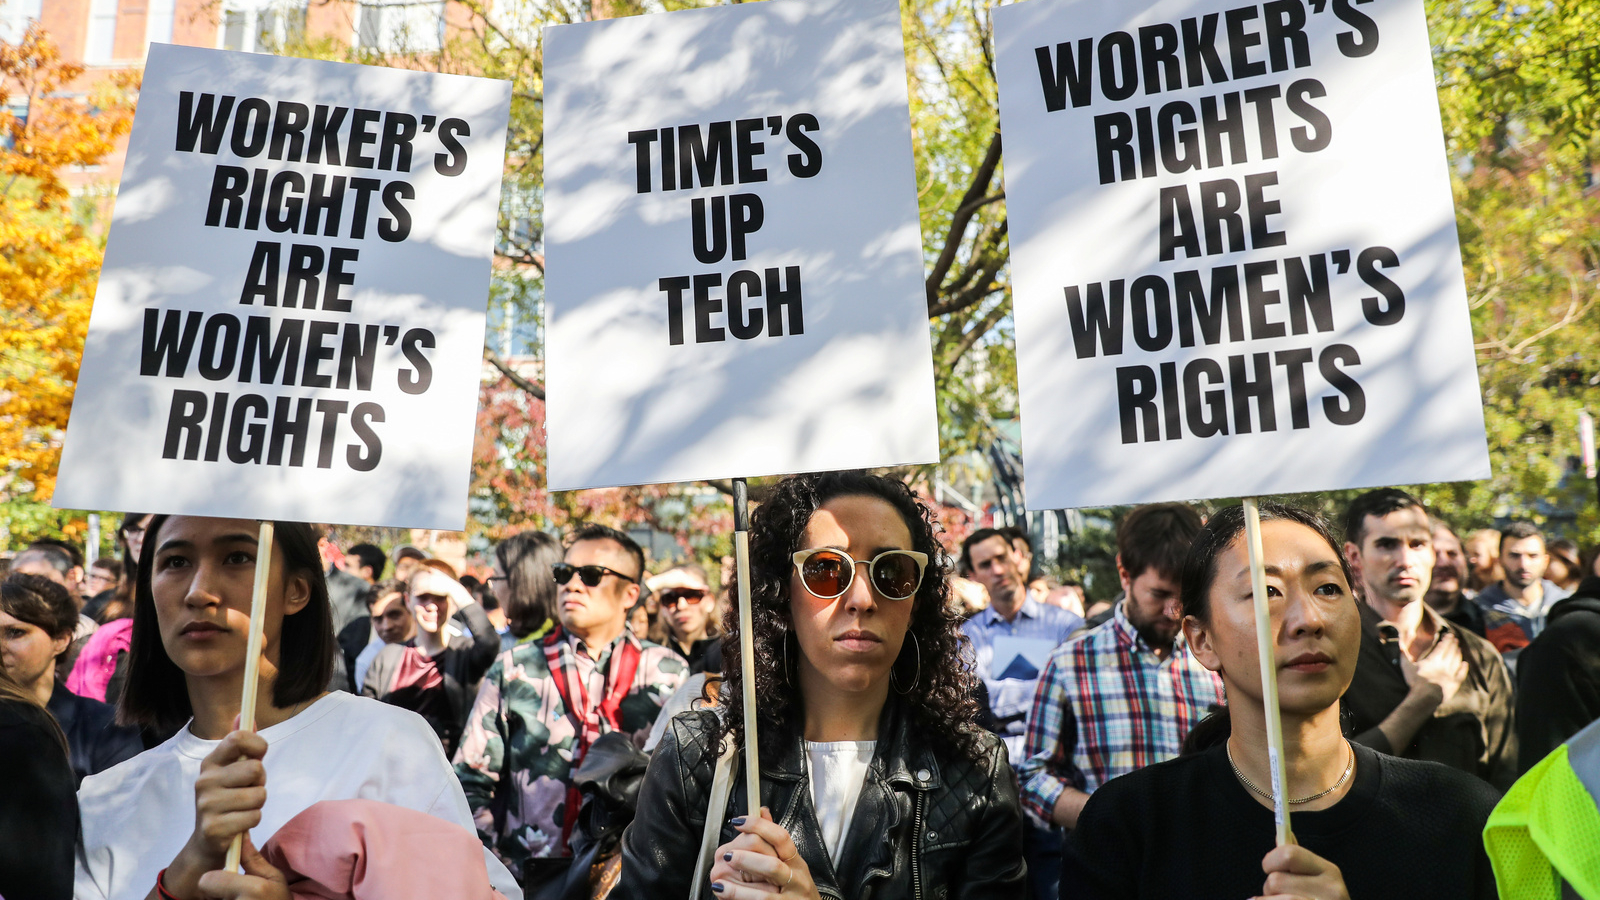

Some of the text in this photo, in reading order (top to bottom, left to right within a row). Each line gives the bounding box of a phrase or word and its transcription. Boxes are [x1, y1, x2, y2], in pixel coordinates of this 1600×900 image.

[1035, 0, 1380, 112] WORKER'S
[176, 91, 471, 176] WORKER'S
[628, 113, 823, 194] TIME'S
[1094, 78, 1332, 185] RIGHTS
[205, 165, 415, 243] RIGHTS
[692, 194, 765, 265] UP
[1159, 171, 1286, 262] ARE
[240, 241, 359, 312] ARE
[659, 266, 805, 346] TECH
[1065, 245, 1407, 358] WOMEN'S
[140, 309, 436, 396] WOMEN'S
[1116, 343, 1366, 444] RIGHTS
[163, 389, 384, 472] RIGHTS
